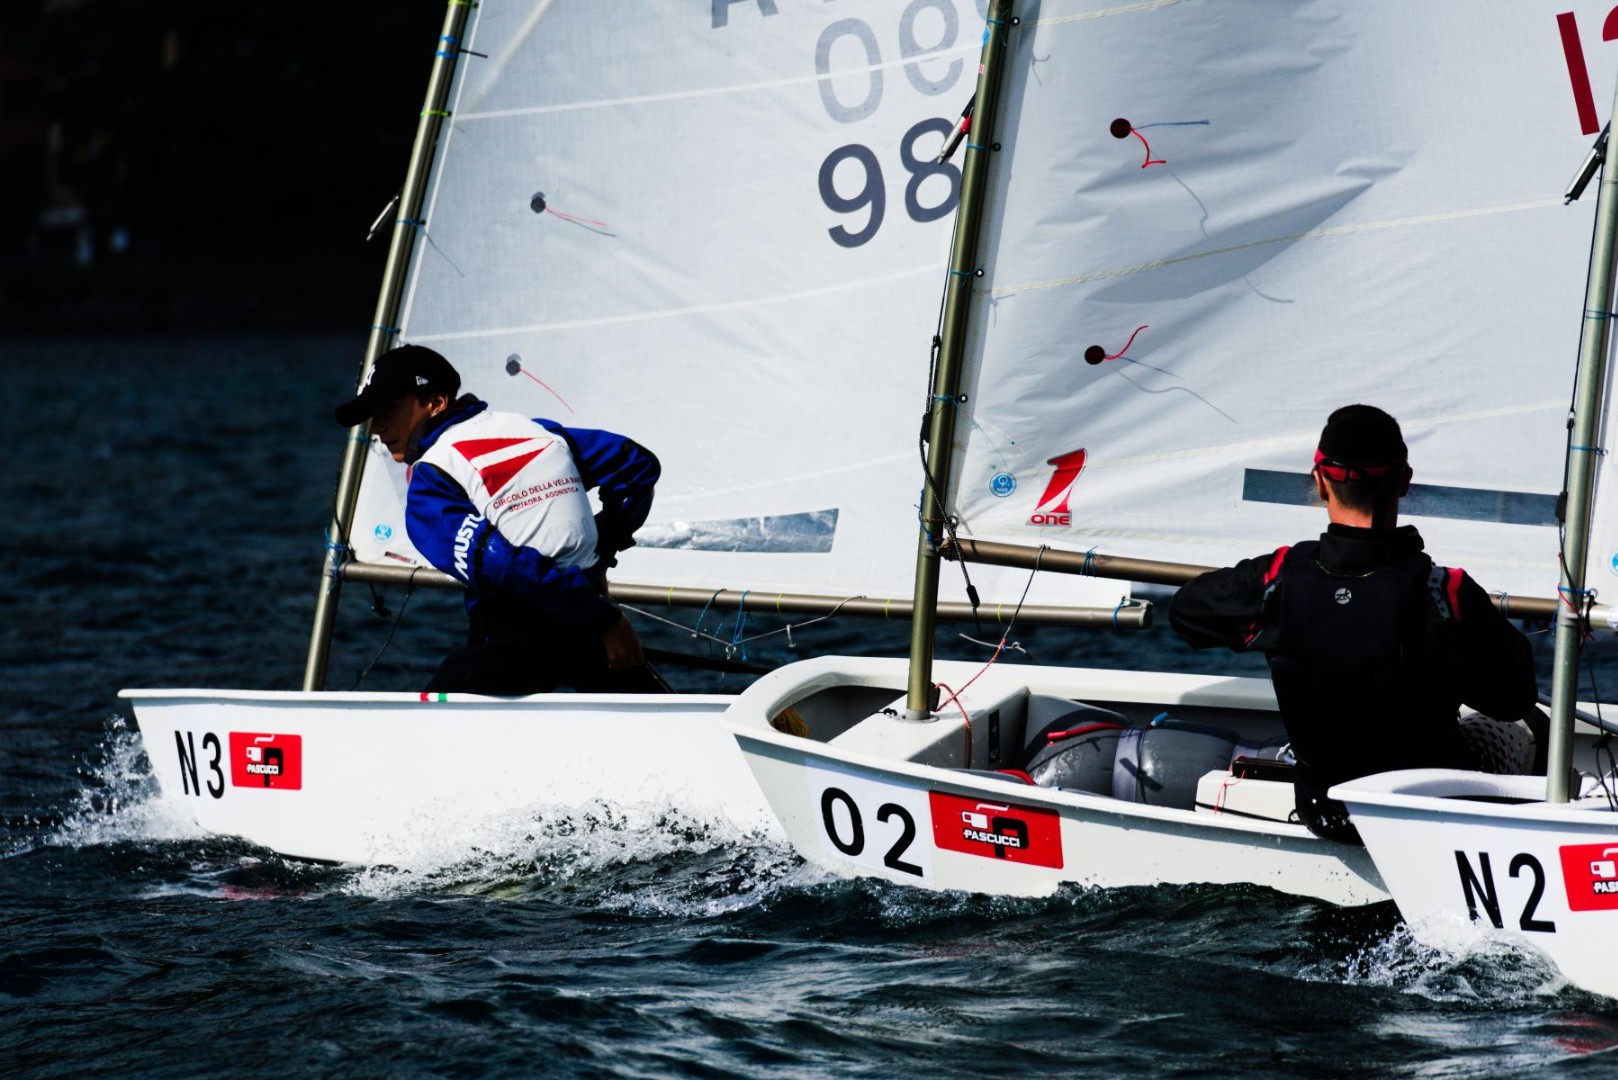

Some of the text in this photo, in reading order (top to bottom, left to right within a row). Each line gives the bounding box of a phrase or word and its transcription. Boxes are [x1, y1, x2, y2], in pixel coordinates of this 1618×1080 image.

[818, 117, 963, 248] 98
[493, 489, 528, 510] CIRCOLO
[528, 483, 553, 495] DELLA
[552, 478, 571, 487] VELA
[508, 486, 579, 512] SQUADRA AGONISTICA
[1030, 514, 1070, 526] ONE
[174, 730, 225, 799] N3
[246, 763, 279, 775] PASCUCCI
[963, 828, 1021, 848] PASCUCCI
[1454, 849, 1557, 933] N2
[1593, 881, 1618, 894] PAS
